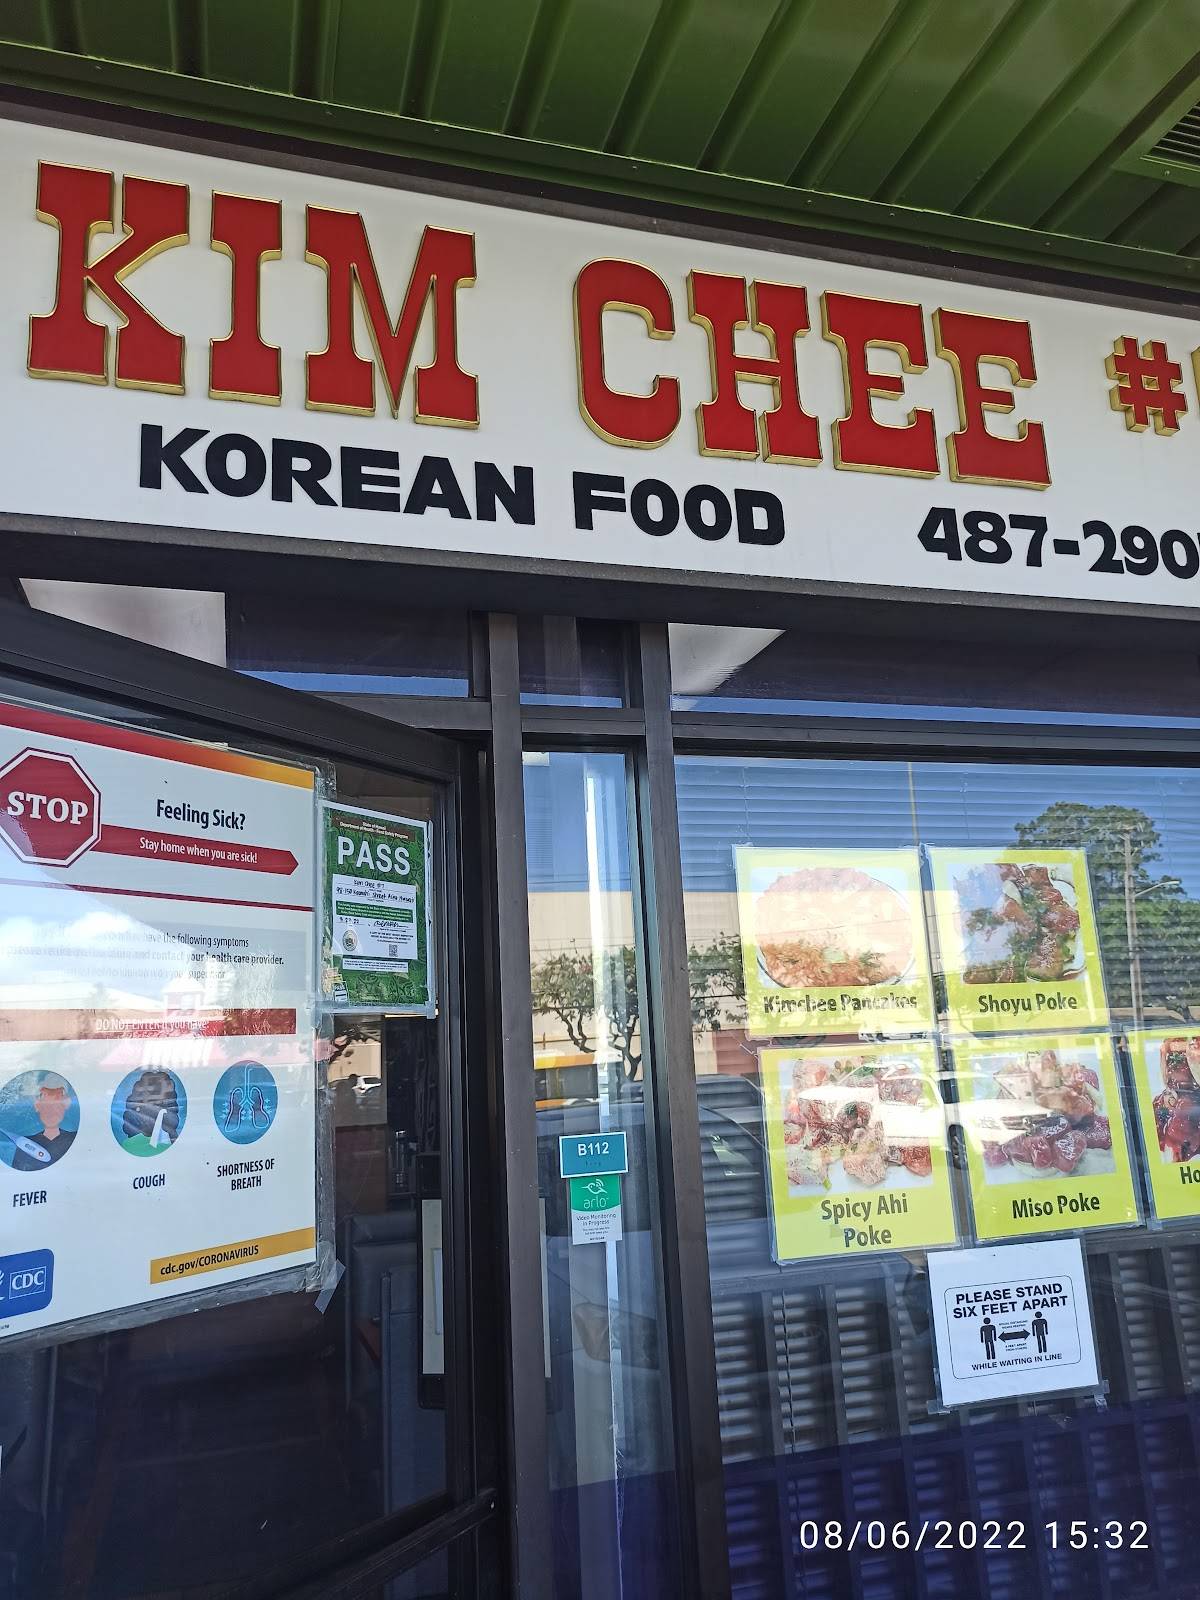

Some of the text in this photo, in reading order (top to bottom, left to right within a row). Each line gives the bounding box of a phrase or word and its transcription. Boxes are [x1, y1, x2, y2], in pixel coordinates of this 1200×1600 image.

[27, 160, 480, 430] KIM
[573, 257, 1053, 491] CHEE
[139, 423, 1200, 580] KOREAN FOOD 487-290
[7, 791, 89, 825] STOP
[157, 798, 246, 831] Feeling Sick?
[140, 836, 258, 864] Stay home when you are sick!
[337, 835, 411, 876] PASS
[178, 932, 212, 947] following
[213, 936, 249, 949] symptoms
[233, 954, 250, 964] care
[251, 954, 284, 966] provider.
[763, 993, 918, 1014] Kimchee Pancakes
[978, 991, 1078, 1016] Shoyu Poke
[111, 1018, 129, 1031] NOT
[577, 1142, 610, 1156] B112
[217, 1158, 275, 1178] SHORTNESS OF
[132, 1173, 166, 1190] COUGH
[231, 1176, 262, 1192] BREATH
[12, 1190, 47, 1208] FEVER
[583, 1195, 607, 1209] arlo
[820, 1192, 908, 1225] Spicy Ahi
[1011, 1194, 1101, 1219] Miso Poke
[843, 1225, 892, 1249] Poke
[160, 1245, 259, 1276] cdc.gov/CORONAVIRUS
[12, 1271, 44, 1290] CDC
[955, 1282, 1063, 1305] PLEASE STAND
[953, 1295, 1068, 1319] SIX FEET APART
[971, 1353, 1062, 1371] WHILE WAITING IN LINE
